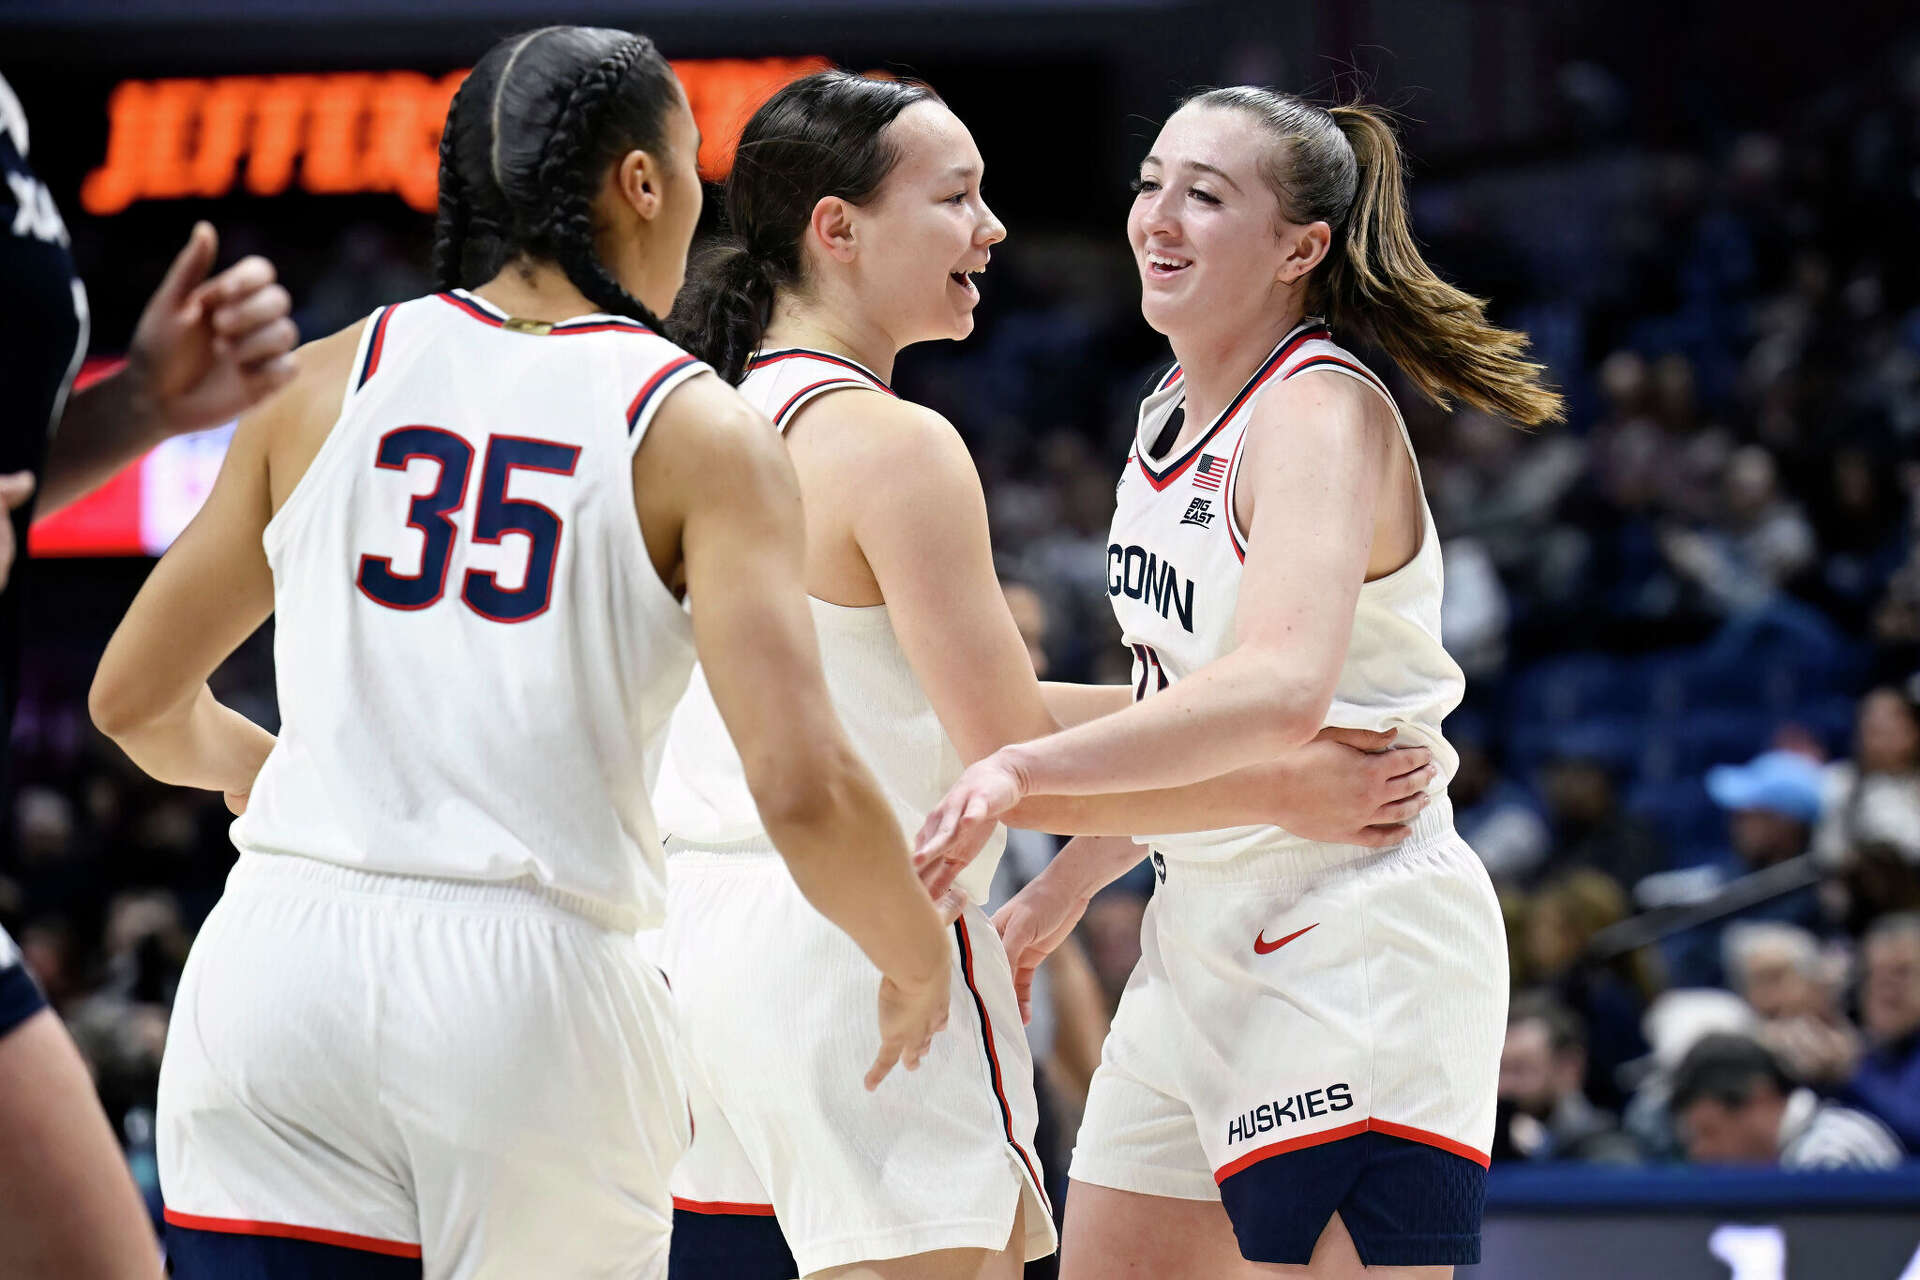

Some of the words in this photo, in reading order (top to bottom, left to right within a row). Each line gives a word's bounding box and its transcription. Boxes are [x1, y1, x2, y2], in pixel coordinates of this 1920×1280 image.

[356, 424, 582, 624] 35
[1184, 508, 1215, 524] EAST
[1189, 497, 1212, 511] BIG
[1107, 543, 1194, 633] CONN
[1227, 1083, 1353, 1145] HUSKIES
